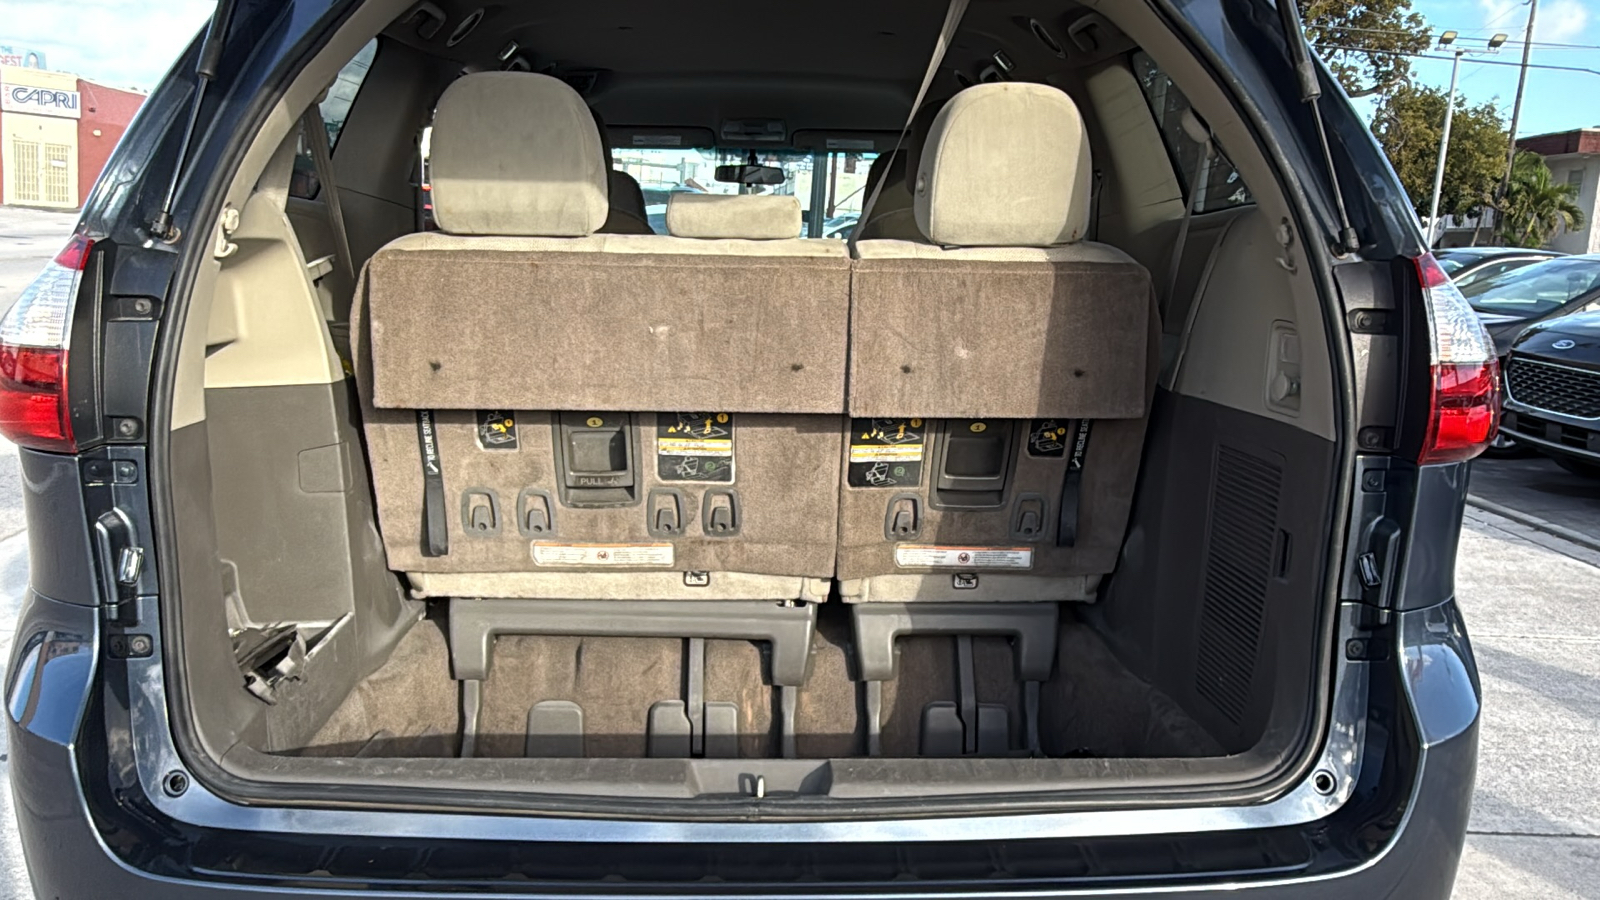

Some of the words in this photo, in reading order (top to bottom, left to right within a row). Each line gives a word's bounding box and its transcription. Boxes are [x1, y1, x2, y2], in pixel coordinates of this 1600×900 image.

[12, 87, 77, 109] CAPRI
[424, 435, 435, 455] RECLINE
[1075, 432, 1087, 451] RECLINE
[580, 477, 603, 485] PULL
